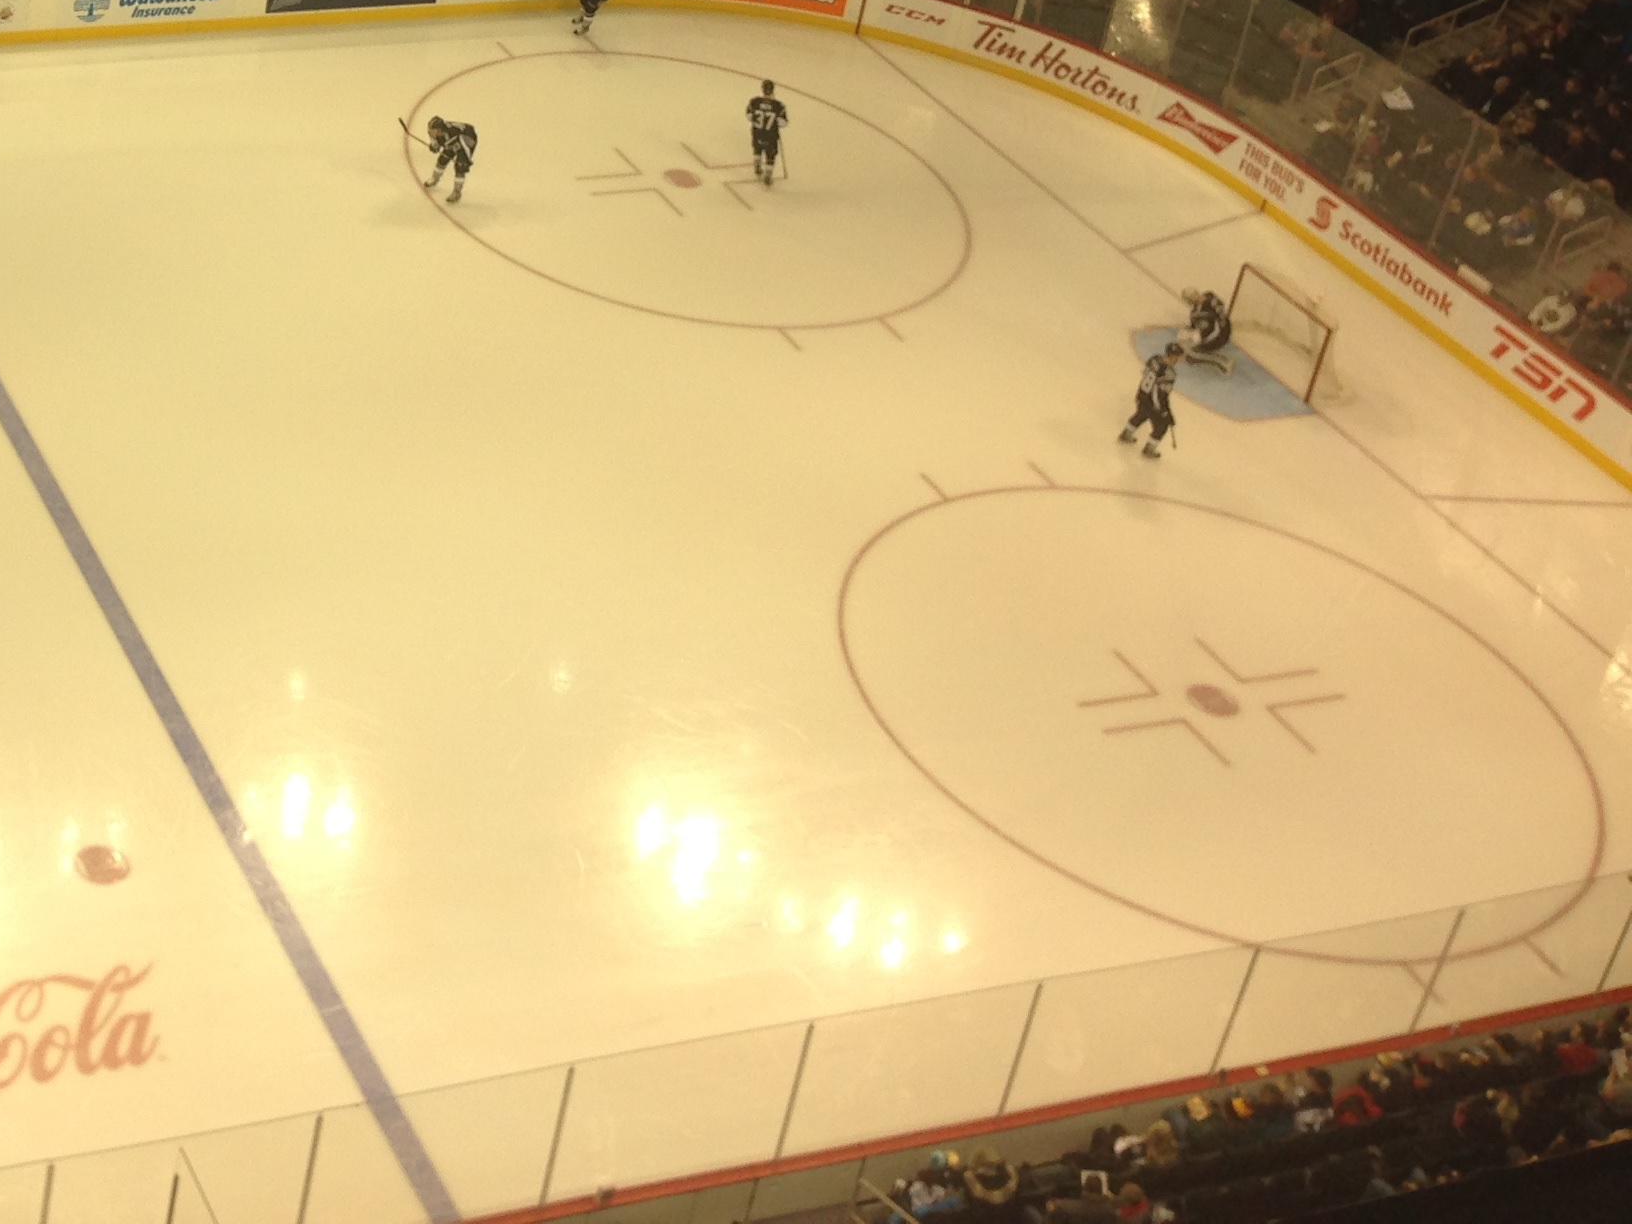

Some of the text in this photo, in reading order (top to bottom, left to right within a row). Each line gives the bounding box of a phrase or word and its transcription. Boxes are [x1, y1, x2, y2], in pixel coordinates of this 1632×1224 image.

[131, 5, 195, 18] Insurance
[885, 2, 946, 26] CCM
[972, 18, 1140, 114] Tim Hortons
[753, 110, 776, 130] 37
[1245, 142, 1270, 168] THIS
[1239, 158, 1262, 183] FOR
[1338, 220, 1454, 317] Scotiabank
[1489, 322, 1598, 422] TSN
